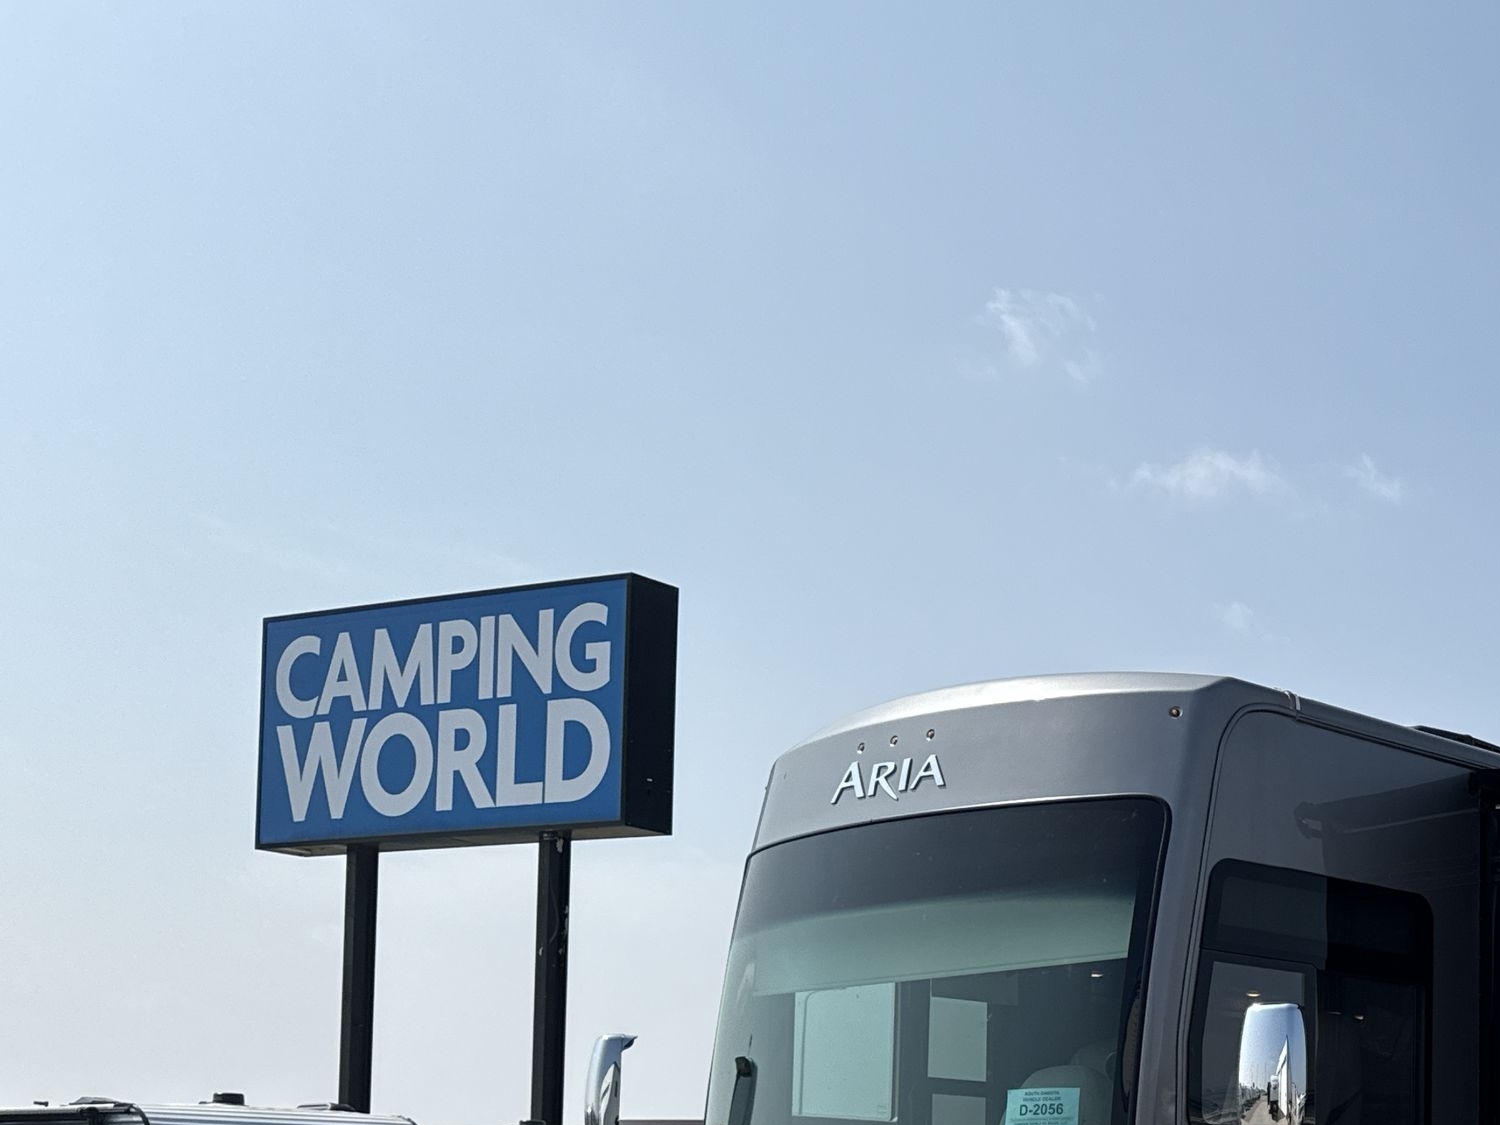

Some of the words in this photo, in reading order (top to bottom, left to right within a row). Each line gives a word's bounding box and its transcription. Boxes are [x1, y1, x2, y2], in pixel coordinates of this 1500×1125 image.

[276, 602, 611, 718] CAMPING
[276, 698, 611, 822] WORLD
[830, 754, 946, 804] ARIA
[1019, 1103, 1064, 1116] D-2056
